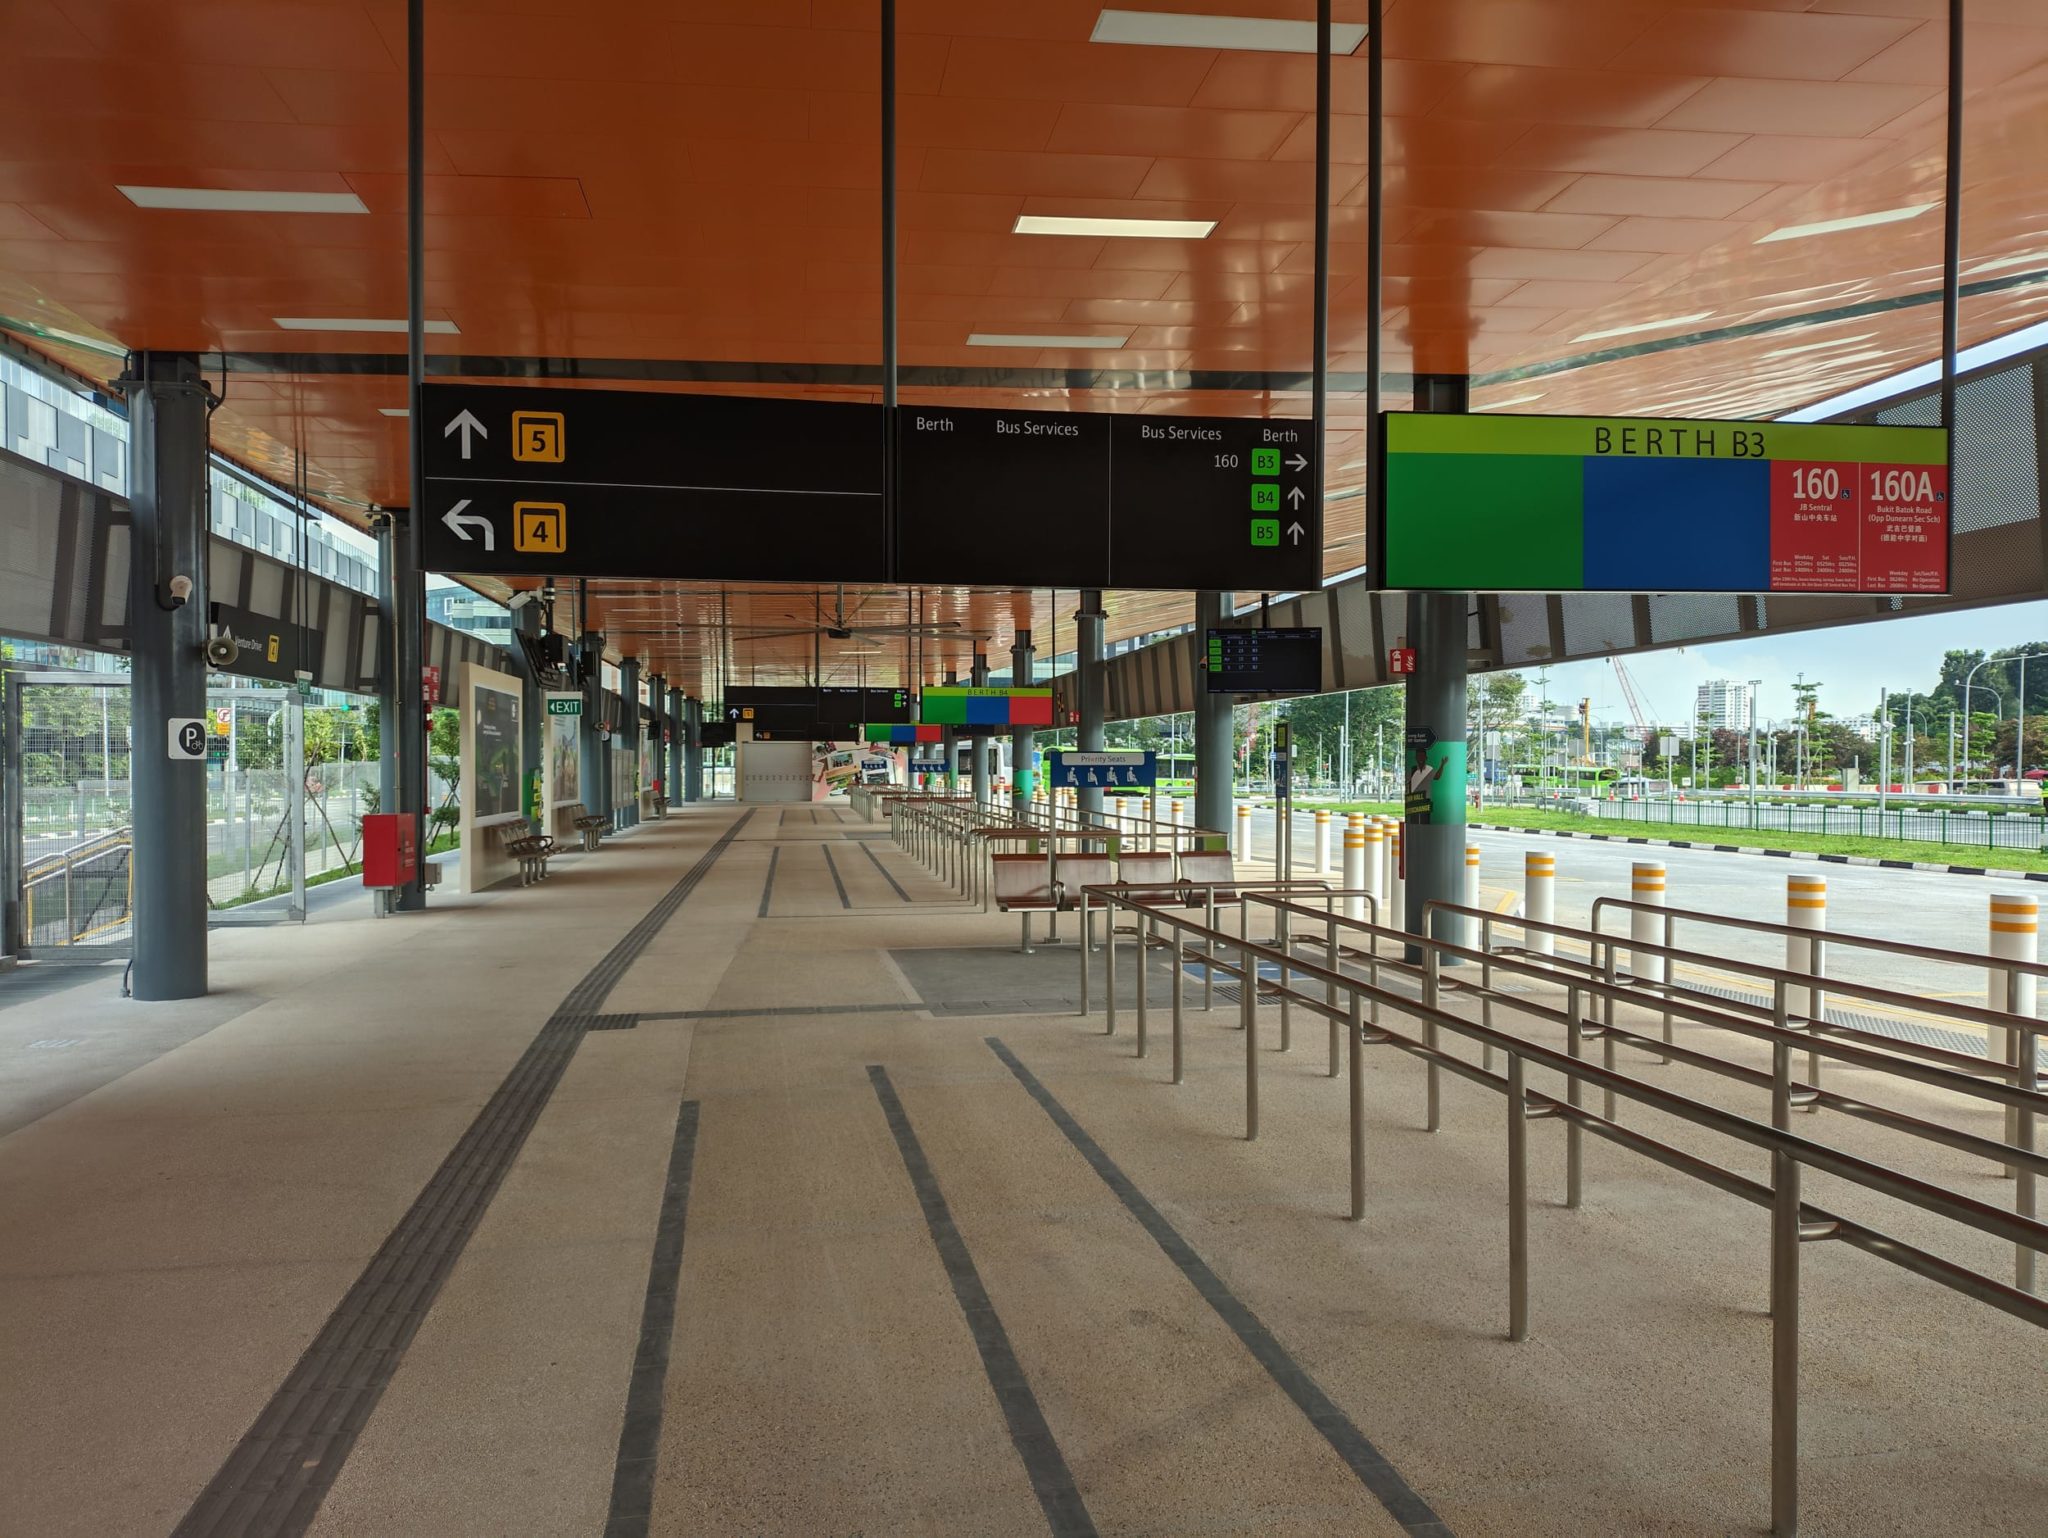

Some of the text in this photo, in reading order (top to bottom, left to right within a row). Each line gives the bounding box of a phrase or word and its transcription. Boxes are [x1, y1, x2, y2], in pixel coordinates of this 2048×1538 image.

[916, 416, 954, 432] Berth
[996, 419, 1079, 436] Bus Services
[1141, 424, 1222, 441] Bus Services
[1262, 428, 1298, 443] Berth
[532, 430, 546, 452] 5
[1595, 426, 1765, 458] BERTH B3
[1213, 454, 1275, 469] 160 B3
[1792, 467, 1839, 500] 160
[1870, 470, 1935, 502] 160A
[1257, 490, 1274, 504] B4
[1800, 503, 1833, 512] JB Sentral
[1876, 505, 1933, 514] Bukit Batok Road
[1868, 513, 1941, 523] (Opp Dunearn Sec Sch)
[532, 521, 549, 543] 4
[1256, 526, 1274, 540] B5
[967, 688, 997, 696] BERTH
[556, 701, 580, 714] EXIT
[185, 727, 198, 748] P
[1080, 755, 1126, 764] Priority Seats
